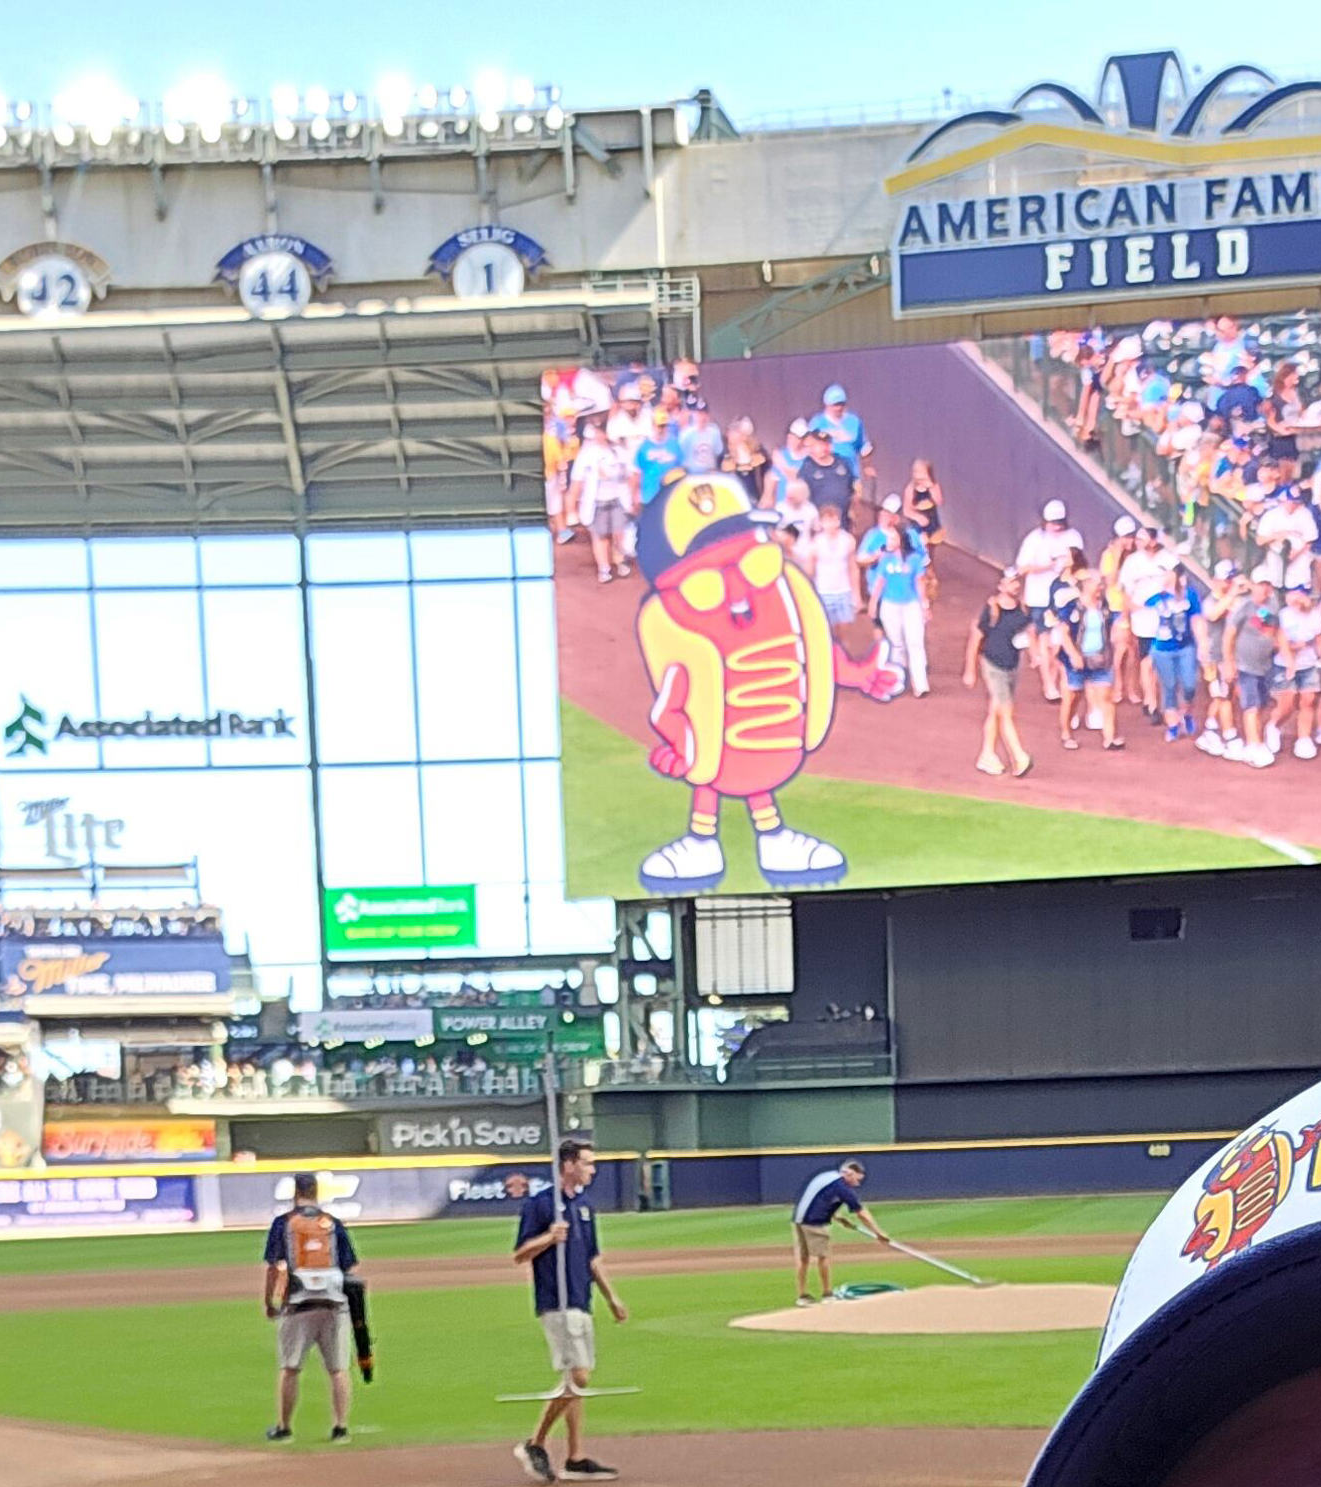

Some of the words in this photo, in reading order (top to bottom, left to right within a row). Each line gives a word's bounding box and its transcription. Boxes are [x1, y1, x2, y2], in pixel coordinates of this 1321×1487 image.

[899, 181, 1177, 247] AMERICAN
[1044, 228, 1250, 291] FIELD
[31, 273, 78, 308] 42
[251, 268, 300, 302] 44
[482, 263, 494, 295] 1
[53, 710, 221, 738] Associated
[229, 708, 296, 738] Bank
[42, 813, 125, 862] Lite
[440, 1015, 497, 1032] POWER
[499, 1014, 547, 1031] ALLEY
[474, 1124, 541, 1147] Save
[449, 1179, 507, 1201] Fleet
